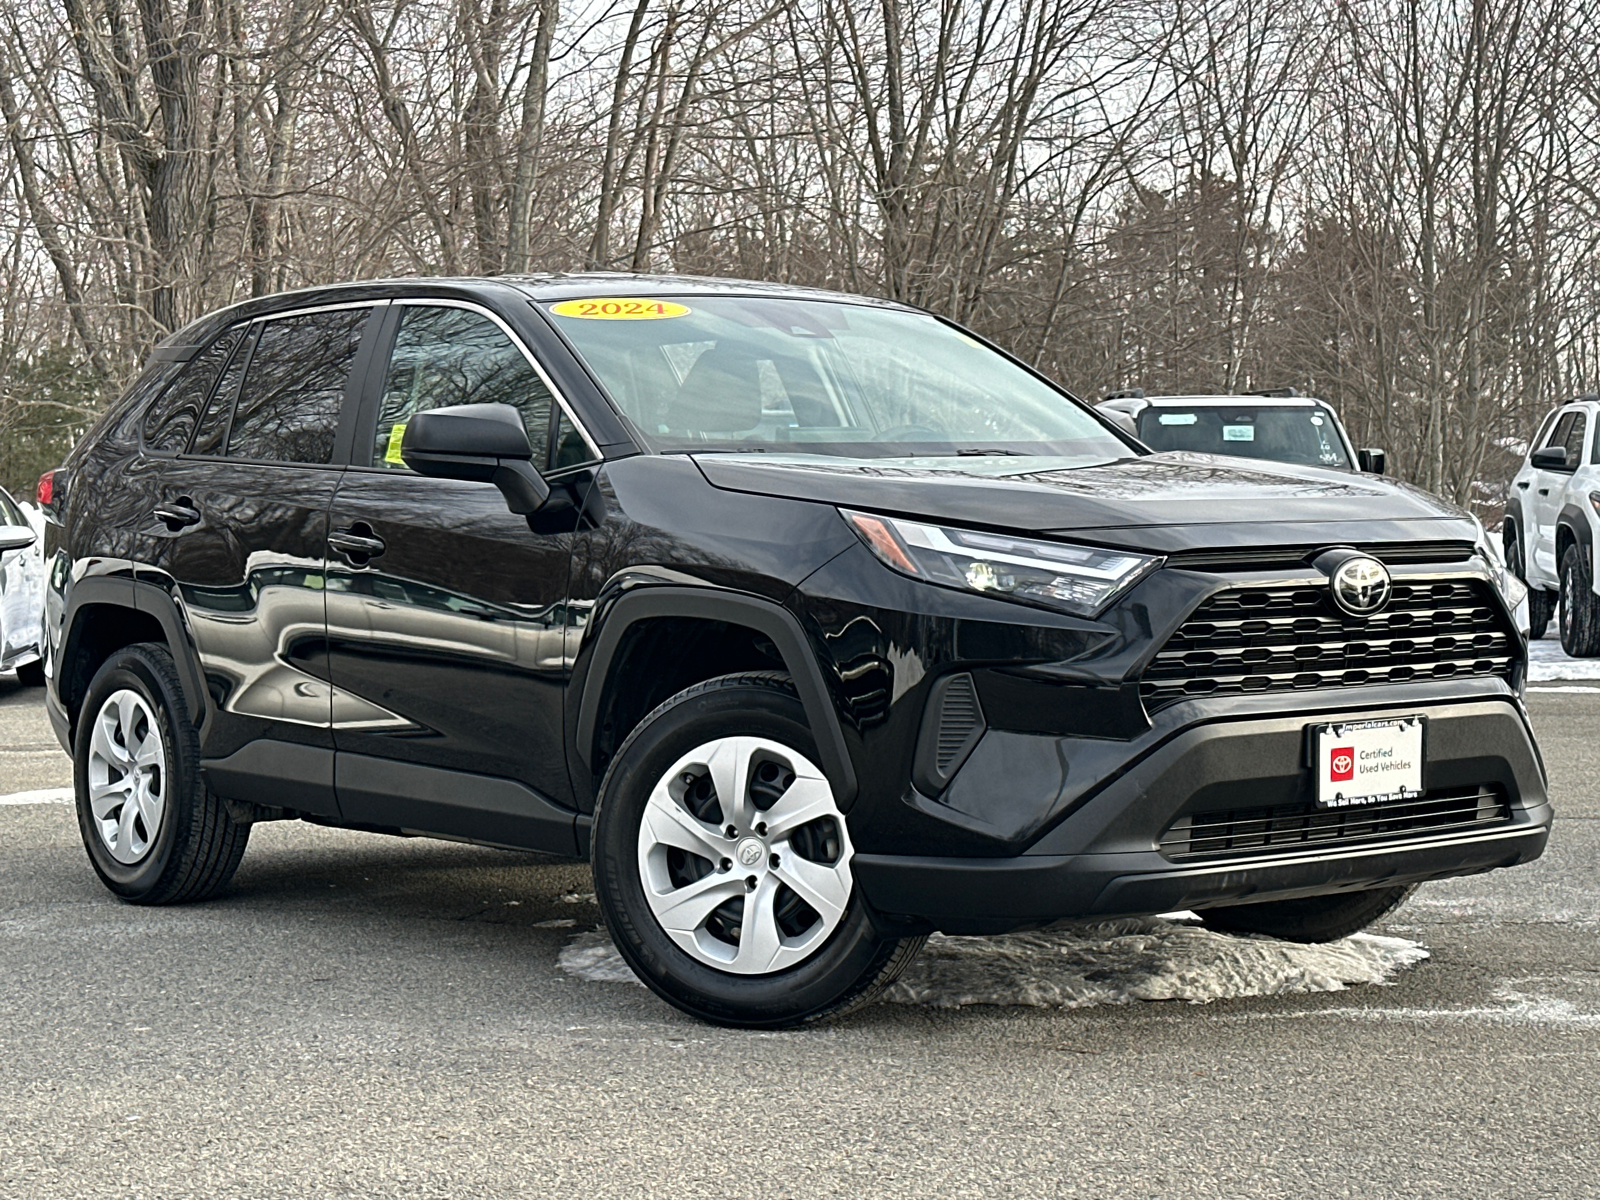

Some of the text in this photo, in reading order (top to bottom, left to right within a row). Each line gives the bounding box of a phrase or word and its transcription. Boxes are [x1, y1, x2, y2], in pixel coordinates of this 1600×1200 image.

[578, 302, 668, 316] 2024
[1360, 747, 1393, 760] Certified
[1360, 760, 1411, 774] Used Vehicles
[1327, 799, 1337, 807] We
[1338, 798, 1349, 807] Sell
[1376, 794, 1387, 802] You
